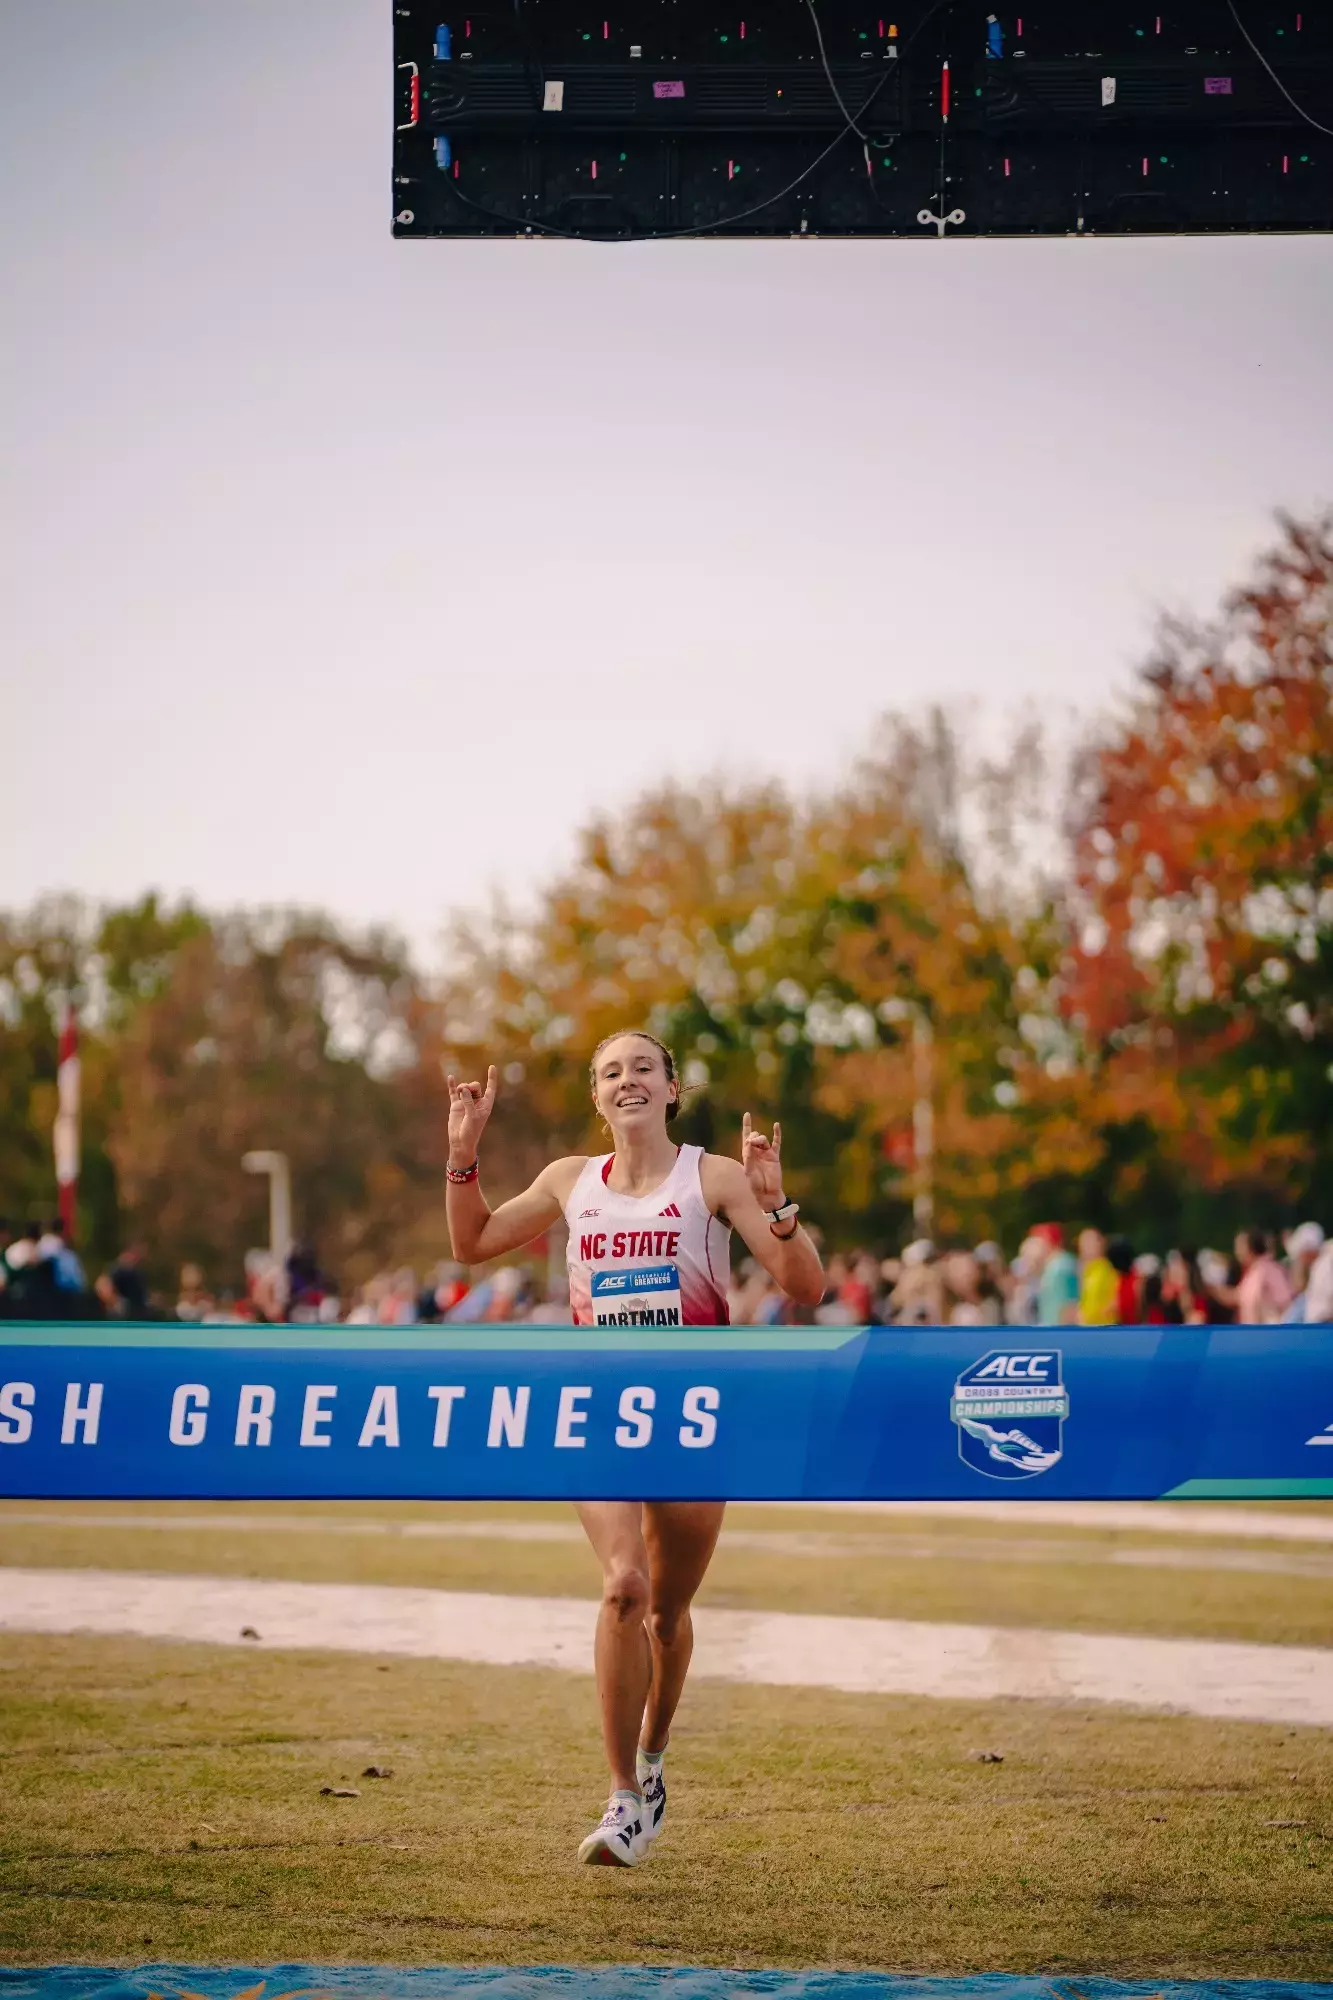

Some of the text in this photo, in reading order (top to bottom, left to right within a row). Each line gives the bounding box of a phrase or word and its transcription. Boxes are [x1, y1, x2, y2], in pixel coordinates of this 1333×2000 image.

[579, 1209, 602, 1219] ACC
[580, 1231, 681, 1260] NC STATE
[597, 1276, 627, 1289] ACC
[634, 1277, 671, 1286] GREATNESS
[597, 1308, 680, 1326] HARTMAN
[976, 1356, 1053, 1377] ACC
[964, 1387, 1053, 1397] CROSS COUNTRY
[168, 1383, 721, 1449] GREATNESS
[955, 1400, 1065, 1416] CHAMPIONSHIPS
